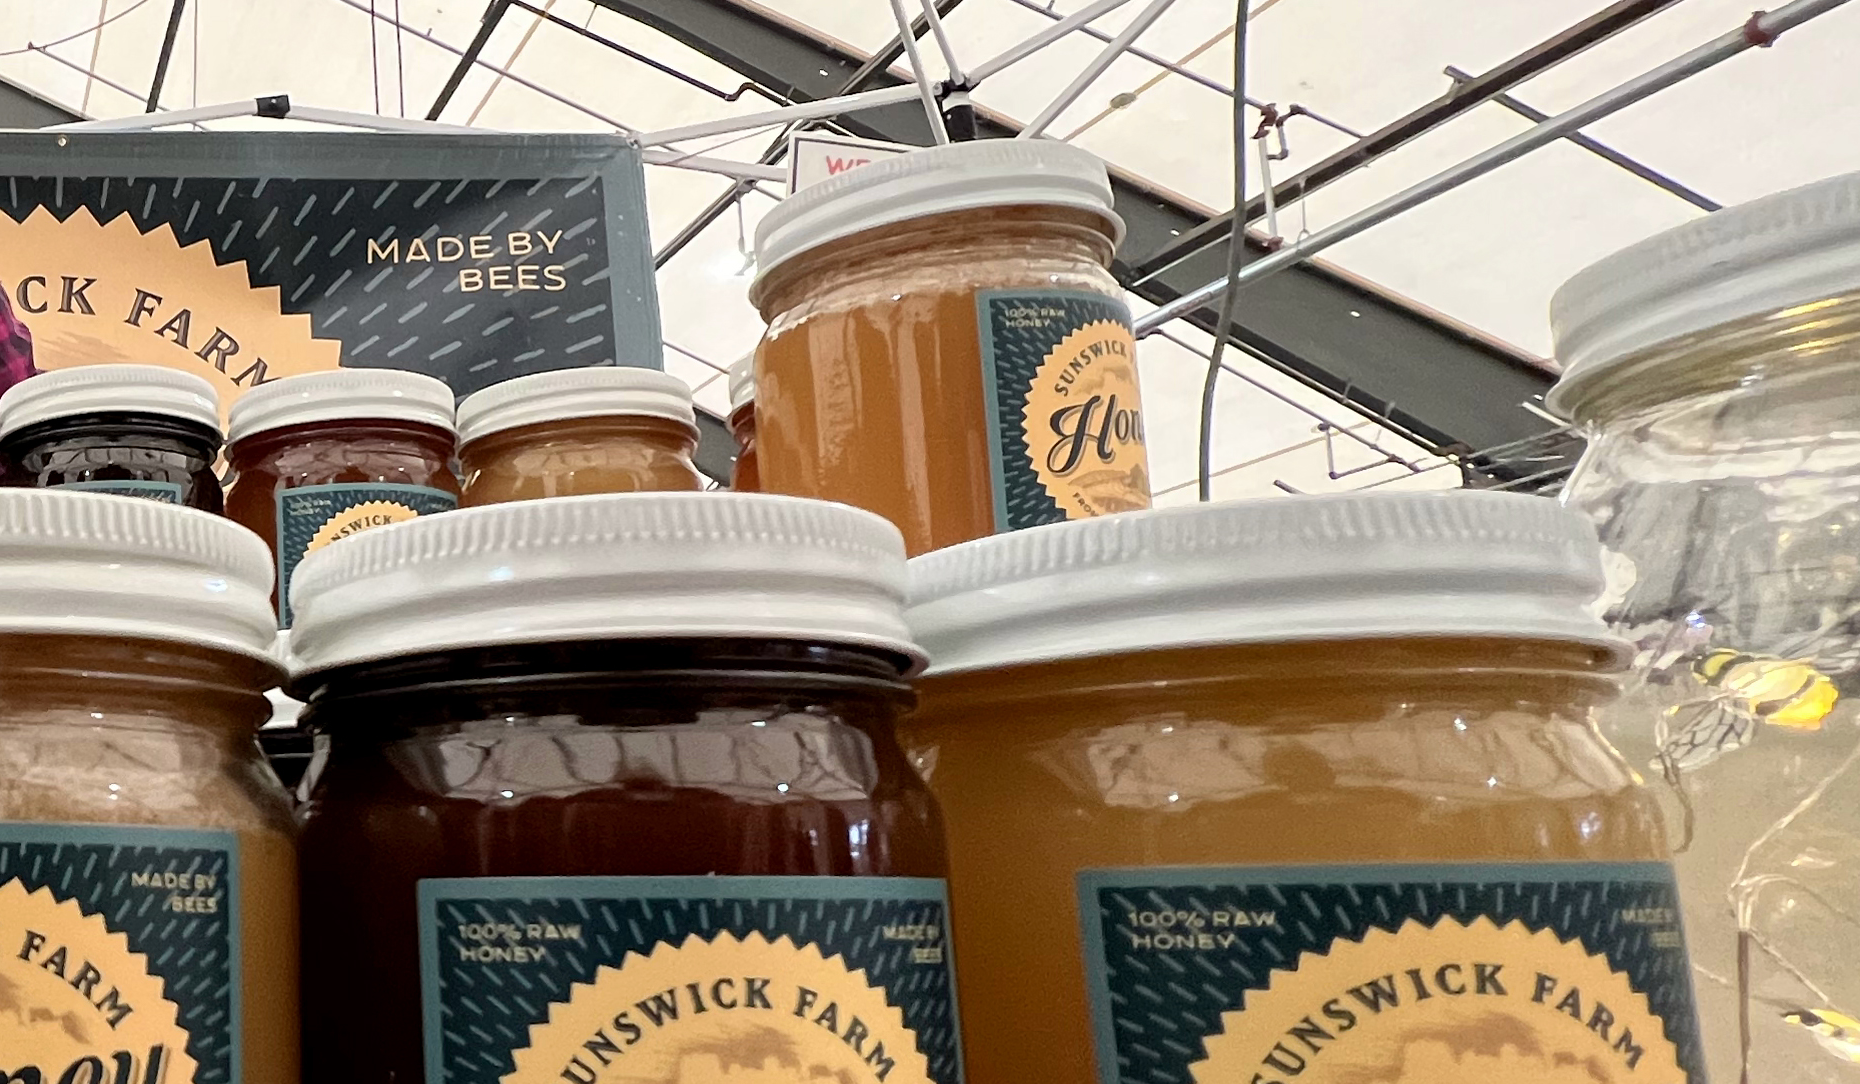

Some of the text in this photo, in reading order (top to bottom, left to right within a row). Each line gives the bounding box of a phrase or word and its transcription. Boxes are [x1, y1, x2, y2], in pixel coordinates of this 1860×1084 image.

[367, 230, 563, 264] MADE BY
[459, 265, 566, 292] BEES
[1054, 339, 1128, 397] SUNSWICK
[131, 872, 217, 889] MADE BY
[1128, 909, 1276, 927] 100% RAW
[459, 924, 582, 940] 100% RAW
[1131, 933, 1235, 950] HONEY
[460, 946, 545, 963] HONEY
[17, 929, 134, 1031] FARM
[793, 986, 895, 1083] FARM
[1531, 972, 1645, 1072] FARM
